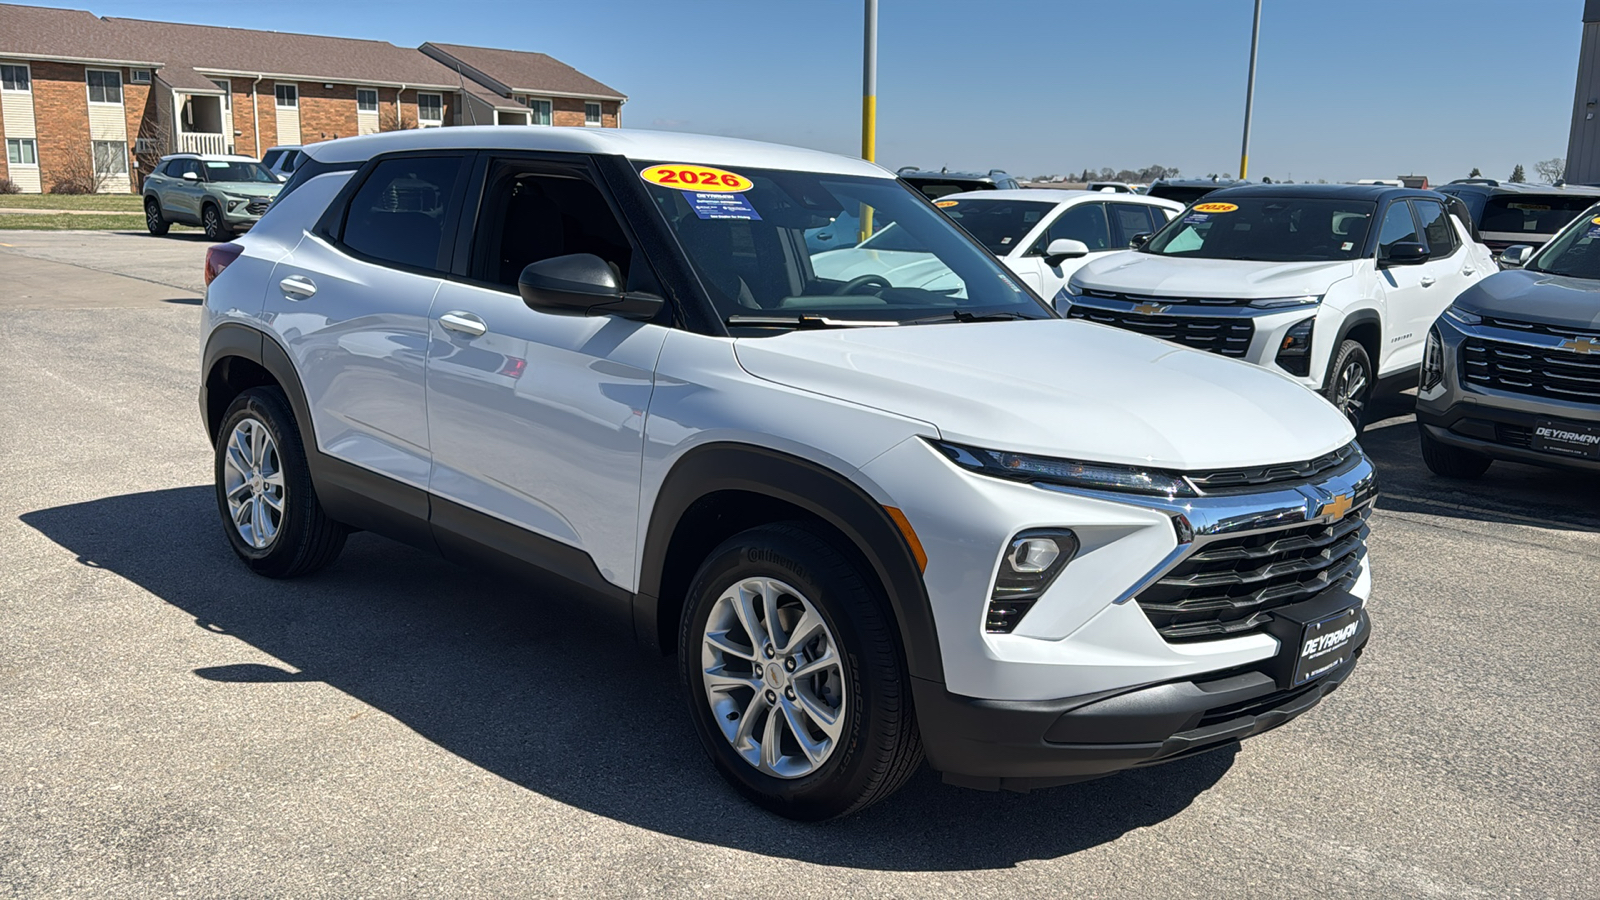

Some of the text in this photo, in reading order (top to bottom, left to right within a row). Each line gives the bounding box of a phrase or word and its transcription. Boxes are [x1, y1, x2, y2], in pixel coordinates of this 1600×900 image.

[657, 169, 741, 187] 2026
[1535, 426, 1600, 444] DEYARMAN
[1301, 620, 1359, 657] DEYARMAN
